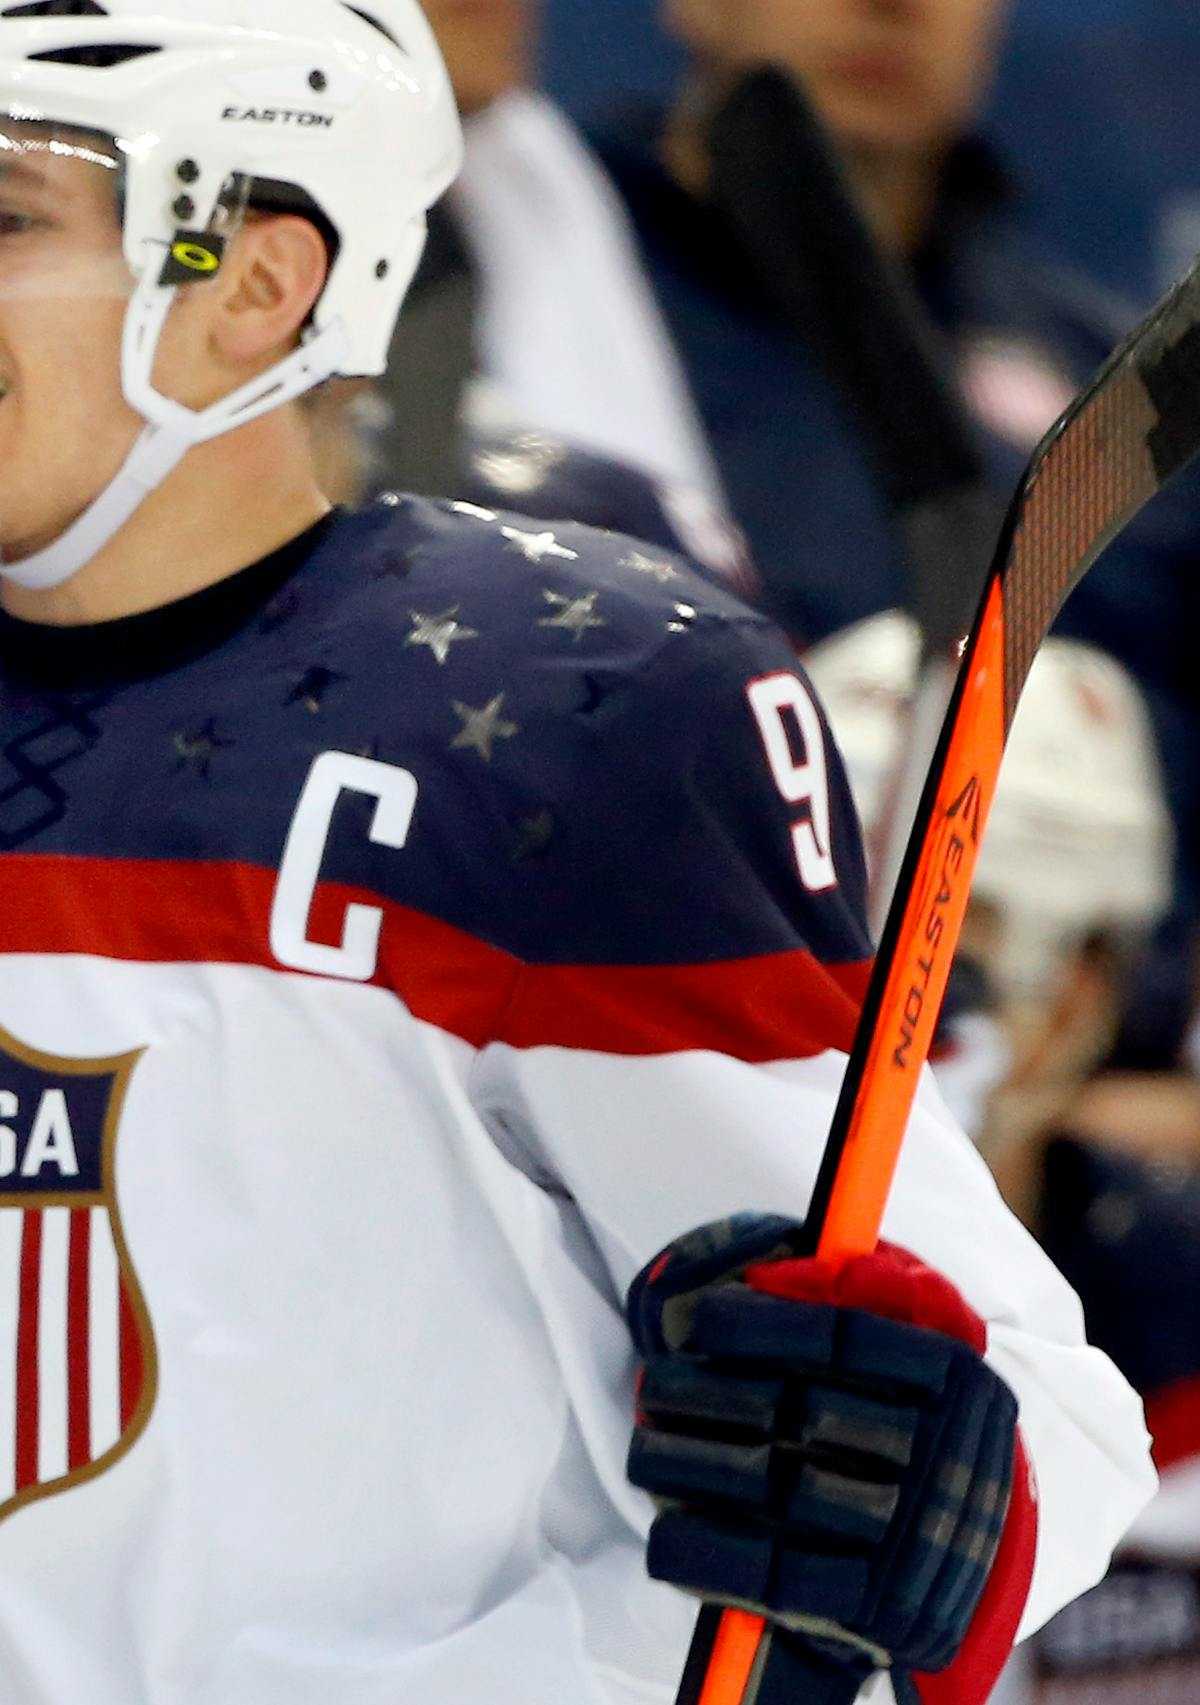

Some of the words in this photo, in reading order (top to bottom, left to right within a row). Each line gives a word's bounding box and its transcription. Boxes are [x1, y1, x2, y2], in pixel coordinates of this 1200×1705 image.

[221, 107, 334, 127] EASTON
[269, 750, 419, 981] C
[746, 669, 838, 893] 9
[893, 833, 964, 1069] EASTON
